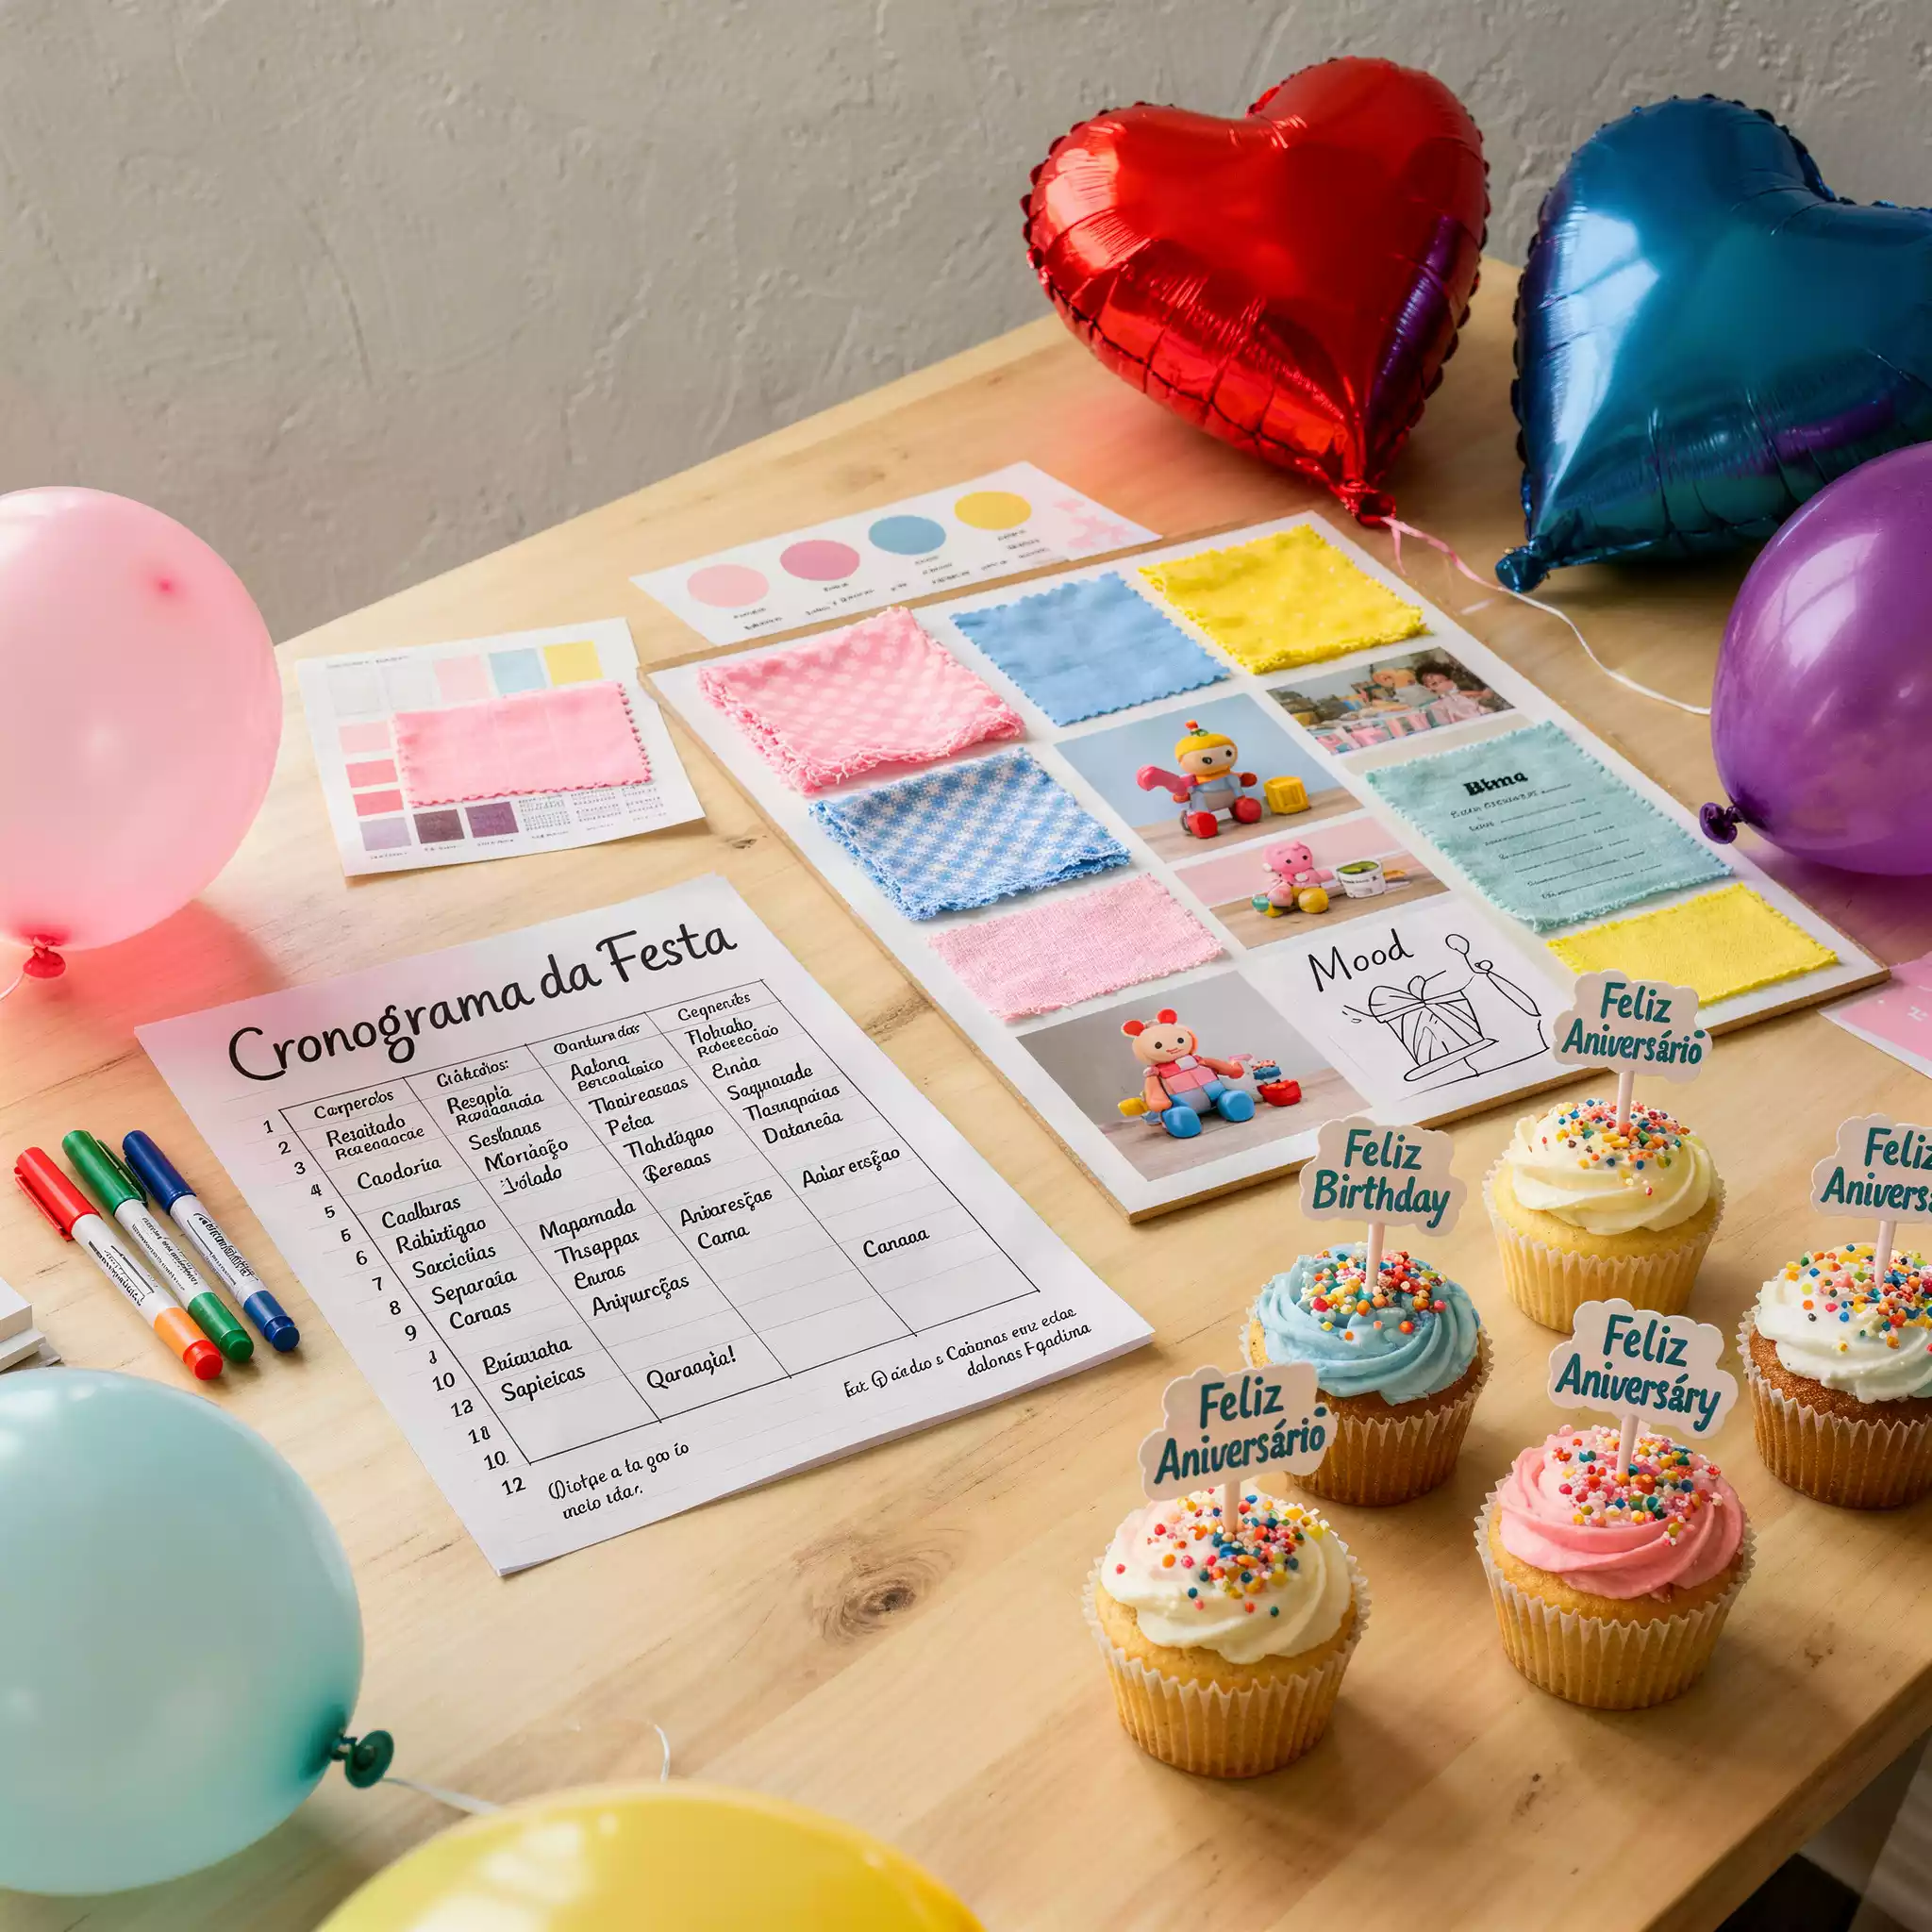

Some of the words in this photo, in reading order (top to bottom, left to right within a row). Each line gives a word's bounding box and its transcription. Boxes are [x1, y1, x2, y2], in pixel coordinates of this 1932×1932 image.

[1307, 928, 1414, 992] Mood
[228, 981, 536, 1080] Cronograma
[541, 954, 602, 998] da
[595, 924, 738, 983] Festa
[1601, 982, 1672, 1024] Feliz
[1561, 1018, 1706, 1064] Aniversário
[263, 1120, 273, 1134] 1
[278, 1141, 291, 1155] 2
[1344, 1129, 1422, 1170] Feliz
[293, 1161, 307, 1174] 3
[310, 1184, 322, 1196] 4
[1312, 1170, 1450, 1228] Birthday
[325, 1206, 335, 1218] 5
[356, 1250, 368, 1265] 6
[372, 1276, 382, 1291] 7
[390, 1301, 401, 1315] 8
[405, 1324, 417, 1341] 9
[1603, 1314, 1688, 1367] Feliz
[432, 1373, 456, 1391] 10
[1555, 1353, 1721, 1432] Aniversáry
[1200, 1375, 1284, 1429] Feliz
[1154, 1407, 1327, 1485] Aniversário
[501, 1477, 525, 1495] 12
